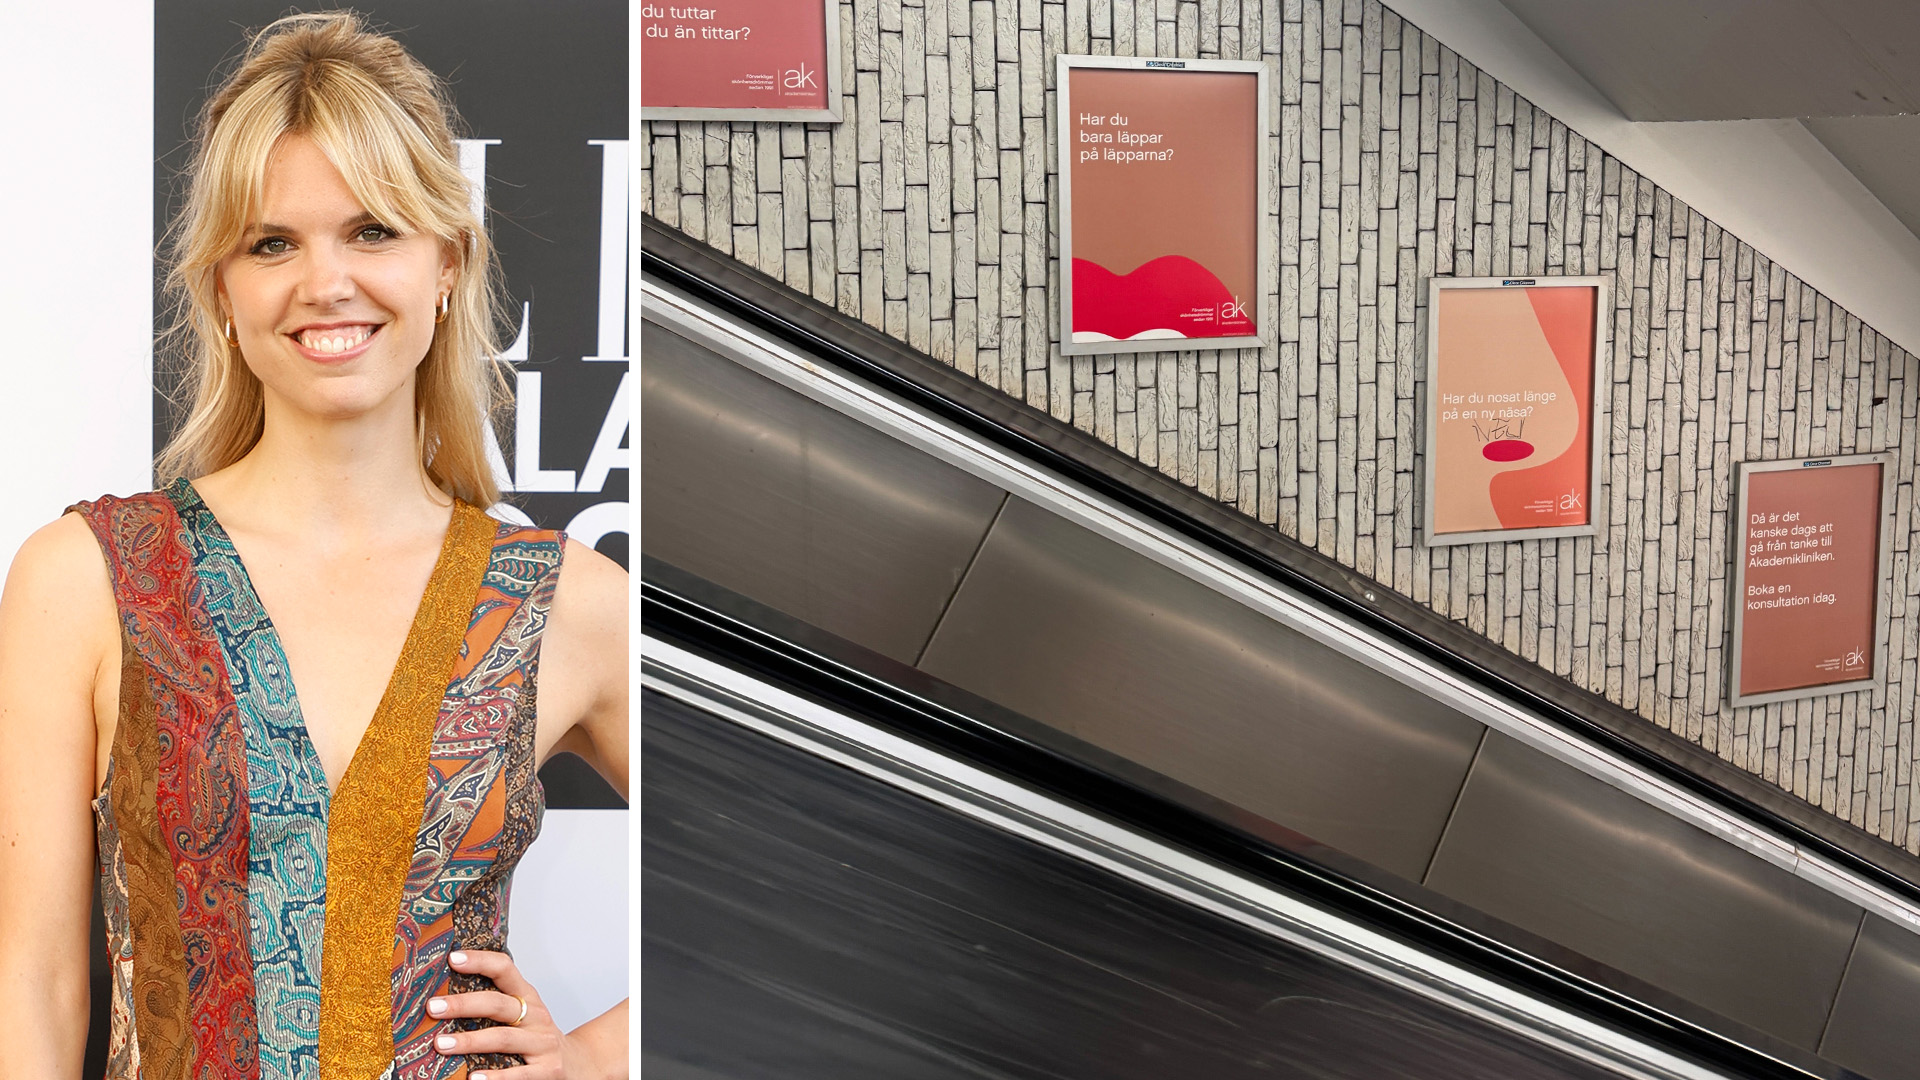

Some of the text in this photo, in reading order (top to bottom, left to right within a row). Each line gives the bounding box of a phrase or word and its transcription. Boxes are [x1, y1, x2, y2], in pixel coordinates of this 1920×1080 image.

[642, 4, 717, 20] du tuttar
[646, 24, 750, 40] du än tittar?
[784, 62, 818, 89] ak
[1080, 113, 1128, 126] Har du
[1080, 130, 1163, 146] bara läppar
[1080, 147, 1174, 164] på läpparna?
[1221, 295, 1248, 319] ak
[1443, 390, 1556, 404] Har du nosat länge
[1442, 406, 1533, 422] på en ny näsa?
[1560, 488, 1582, 510] ak
[1751, 511, 1800, 524] Då är det
[1750, 523, 1833, 539] kanske dags att
[1749, 535, 1832, 555] gå från tanke till
[1749, 551, 1835, 568] Akademikliniken.
[1748, 584, 1791, 596] Boka en
[1747, 592, 1837, 610] konsultation idag.
[1845, 645, 1865, 666] ak
